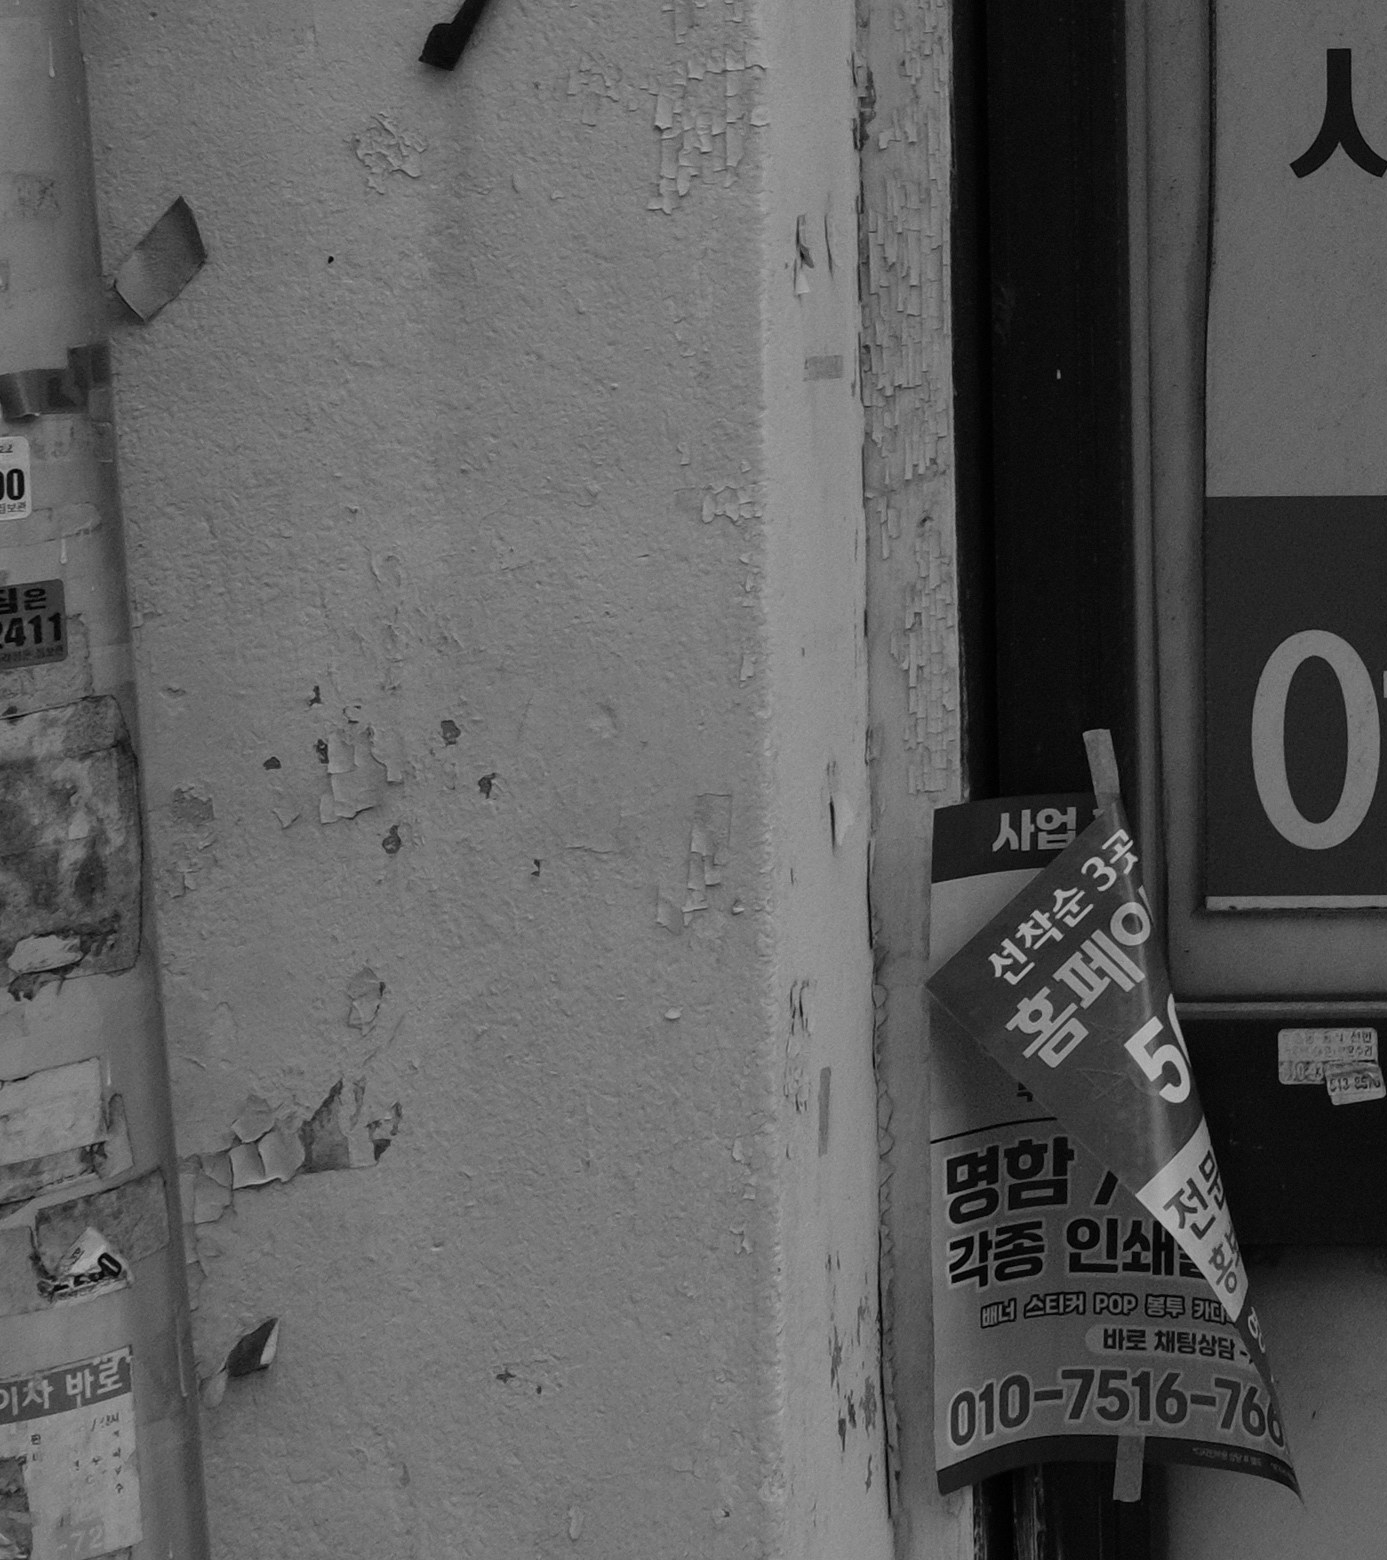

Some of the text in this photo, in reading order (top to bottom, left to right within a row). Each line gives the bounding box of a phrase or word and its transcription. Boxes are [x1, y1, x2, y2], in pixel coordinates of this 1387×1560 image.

[992, 806, 1078, 852] 사업
[987, 885, 1094, 985] 선착순
[946, 1136, 1075, 1224] 명함
[949, 1220, 1045, 1287] 각종
[980, 1298, 1017, 1328] 배너
[1024, 1292, 1086, 1319] 스티커
[1094, 1292, 1138, 1316] POP
[1145, 1294, 1185, 1318] 봉투
[1102, 1328, 1148, 1351] 바로
[1154, 1330, 1235, 1361] 채팅상담
